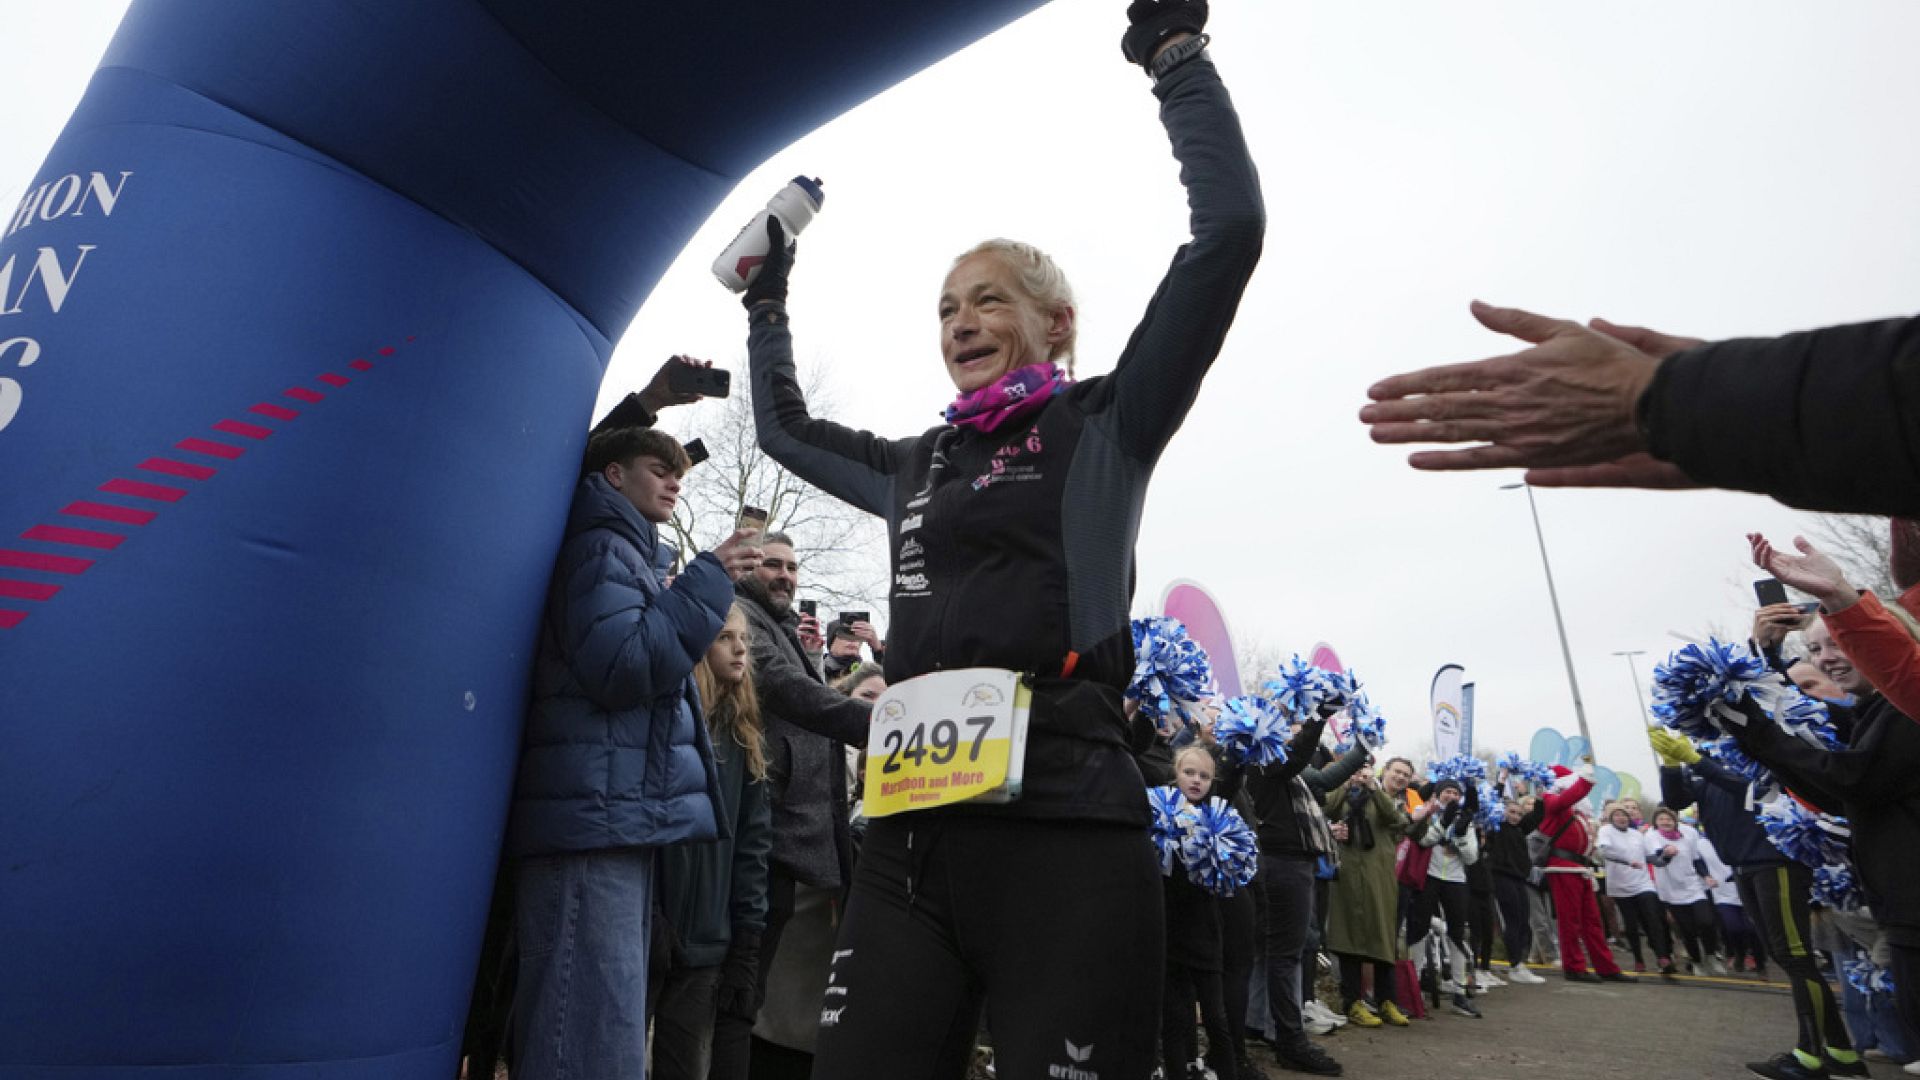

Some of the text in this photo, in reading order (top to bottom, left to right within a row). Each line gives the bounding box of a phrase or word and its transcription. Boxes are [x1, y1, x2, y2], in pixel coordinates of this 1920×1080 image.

[882, 716, 995, 774] 2497
[881, 771, 984, 796] Marathon and More
[1048, 1063, 1099, 1080] erima
